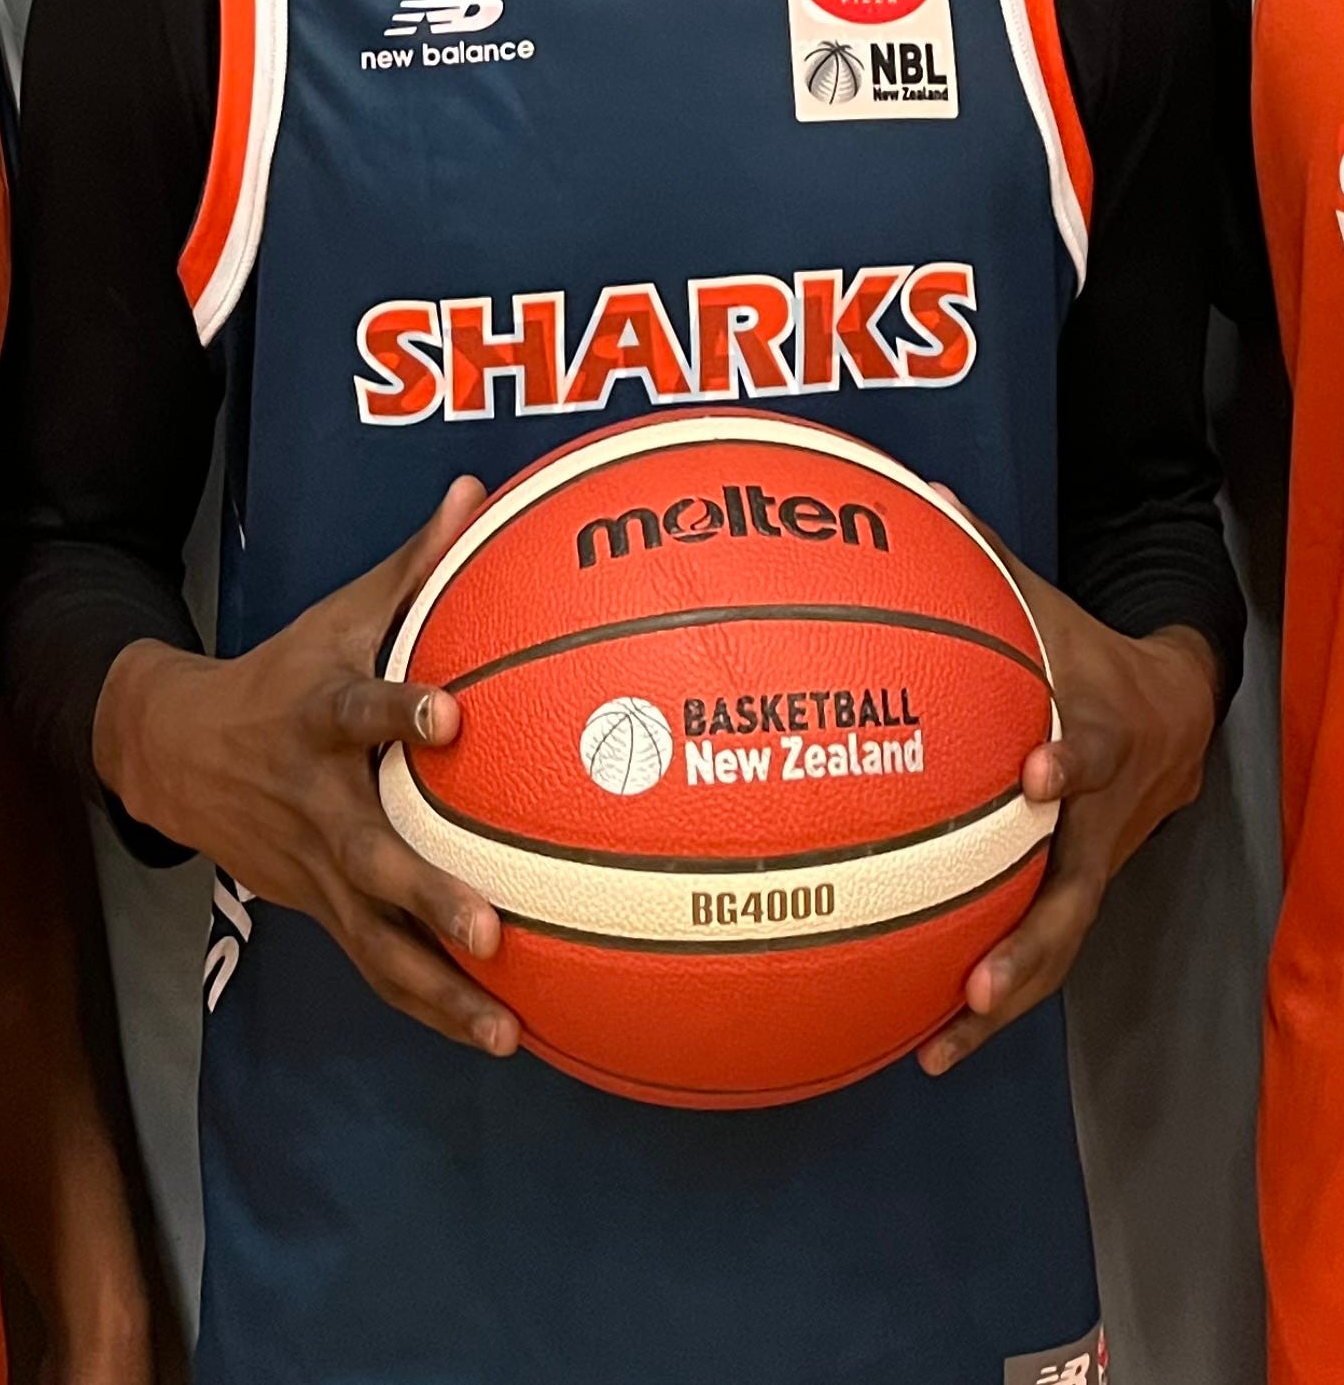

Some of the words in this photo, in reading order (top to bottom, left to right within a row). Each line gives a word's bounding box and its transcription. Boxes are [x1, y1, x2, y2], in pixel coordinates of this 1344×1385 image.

[360, 49, 414, 71] new
[422, 39, 535, 67] balance
[870, 42, 948, 86] NBL
[873, 87, 899, 101] New
[903, 87, 949, 102] Zealand
[354, 263, 977, 426] SHARKS
[575, 485, 890, 570] molten
[682, 687, 921, 737] BASKETBALL
[684, 740, 772, 786] New
[781, 730, 924, 781] Zealand
[691, 883, 835, 926] BG4000
